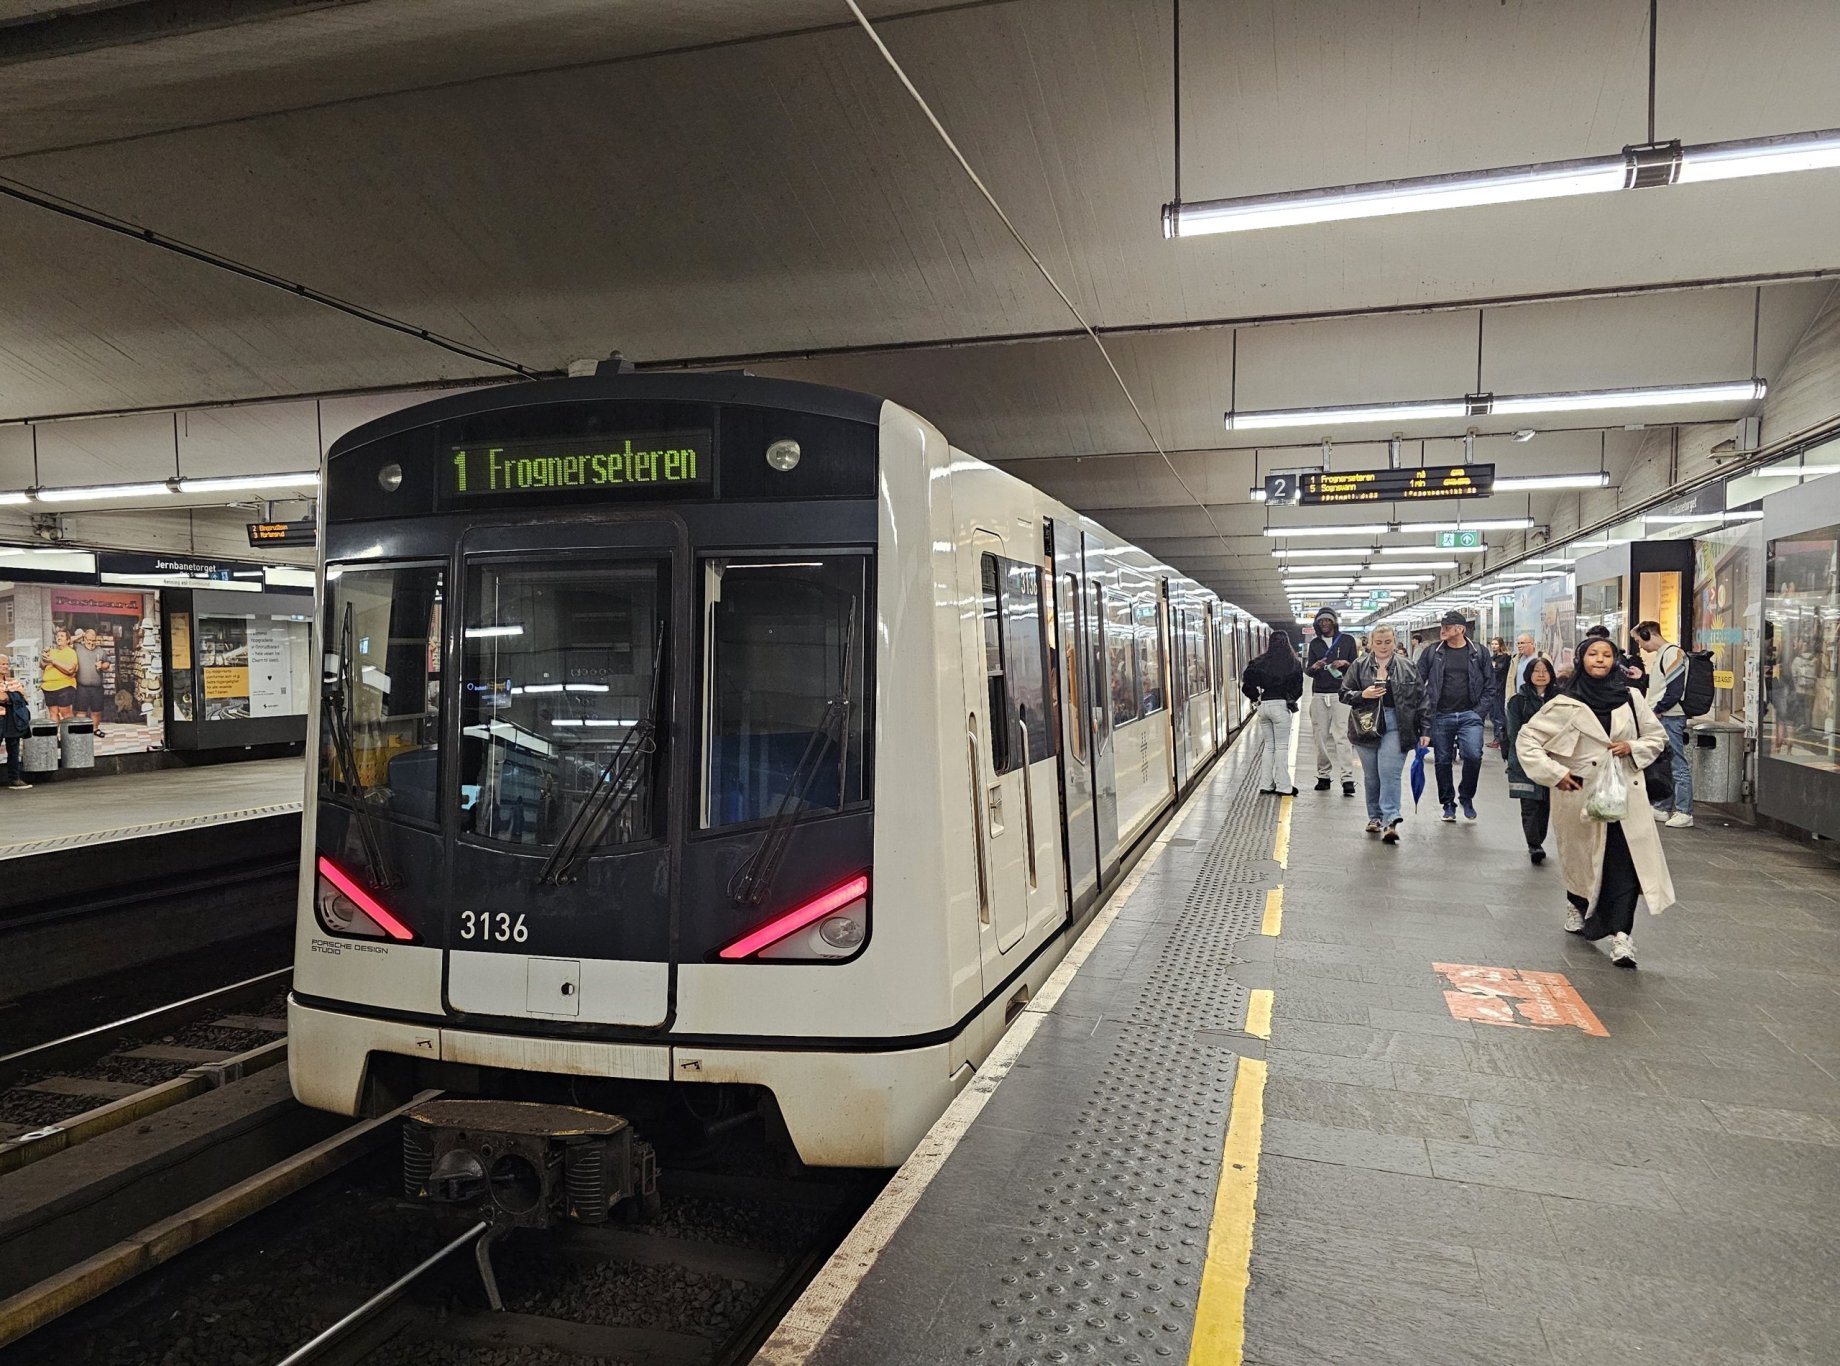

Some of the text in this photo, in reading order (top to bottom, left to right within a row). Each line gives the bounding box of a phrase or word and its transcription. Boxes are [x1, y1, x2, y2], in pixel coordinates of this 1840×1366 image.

[454, 440, 697, 491] 1 Frognerseteren
[1274, 478, 1286, 497] 2
[1309, 484, 1316, 493] 5
[155, 560, 217, 573] Jernbanetorget
[460, 910, 529, 943] 3136
[311, 938, 389, 955] PORSCHE DESIGN
[311, 945, 341, 956] STUDIO
